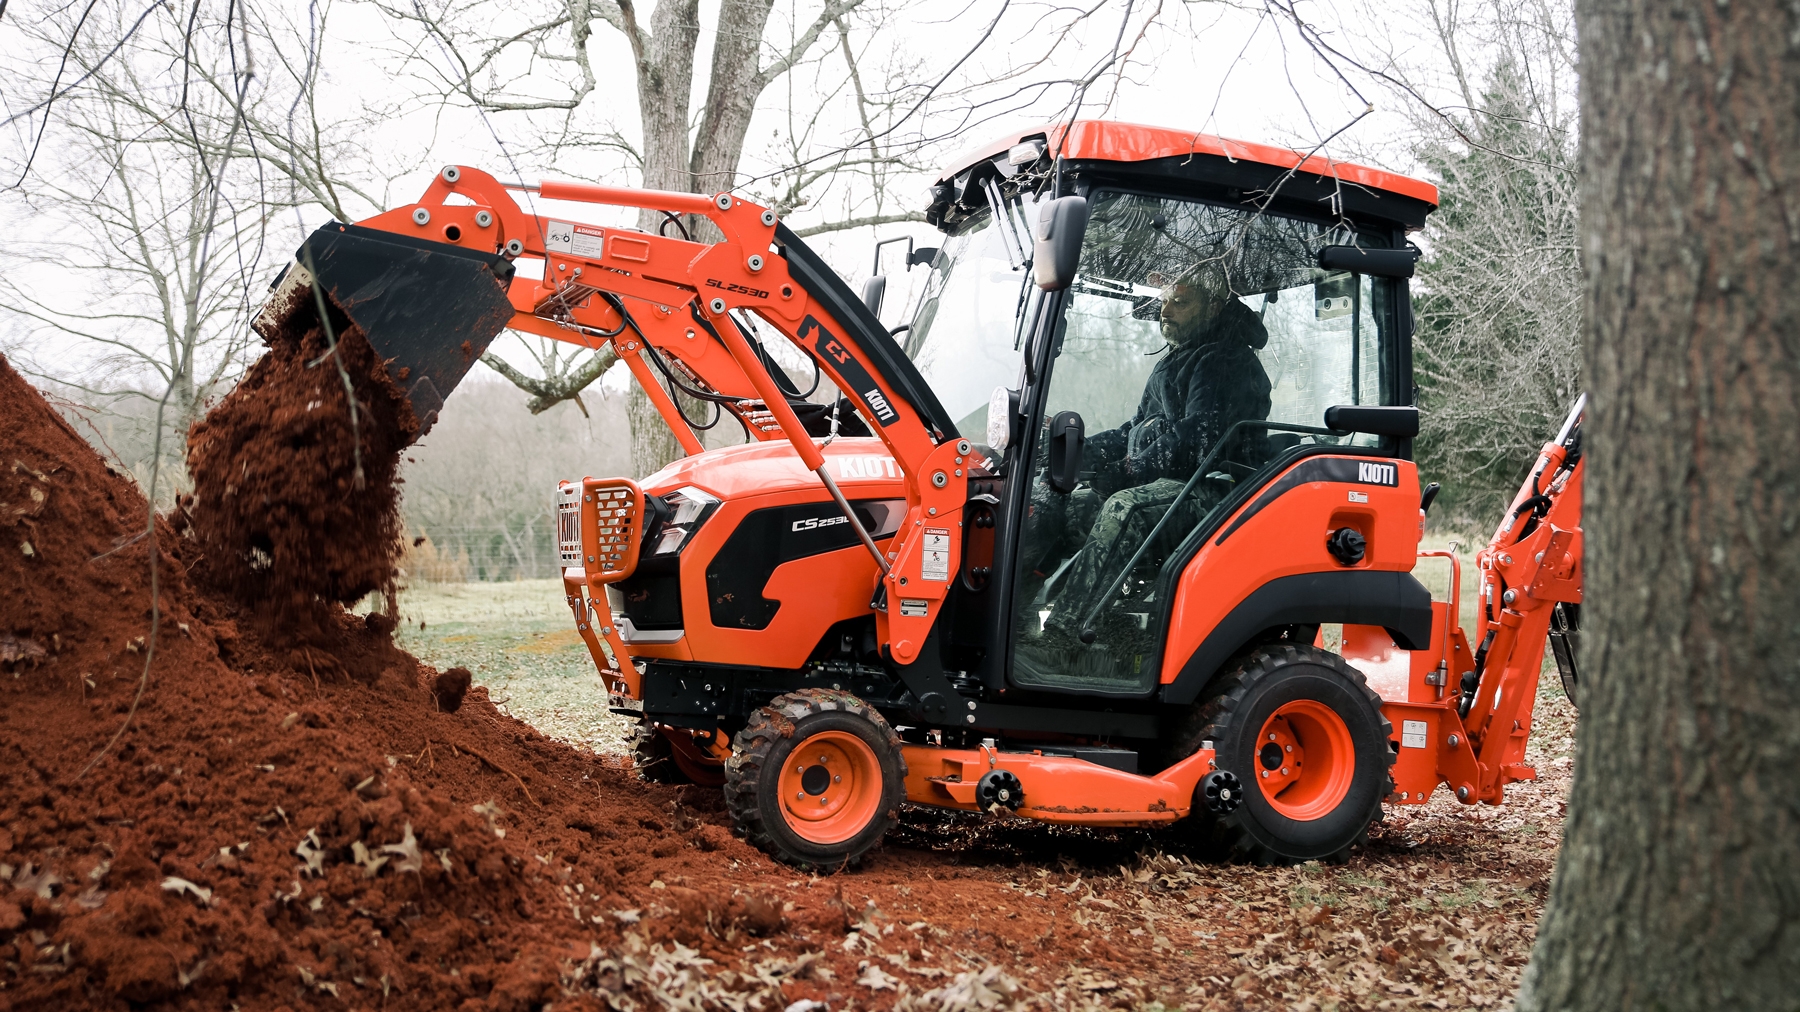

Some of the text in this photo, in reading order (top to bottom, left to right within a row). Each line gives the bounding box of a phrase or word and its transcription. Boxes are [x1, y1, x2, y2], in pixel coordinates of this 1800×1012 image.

[705, 278, 770, 299] SL2530
[825, 340, 851, 364] CS
[864, 388, 895, 421] KIOTI
[1358, 462, 1394, 485] KIOTI
